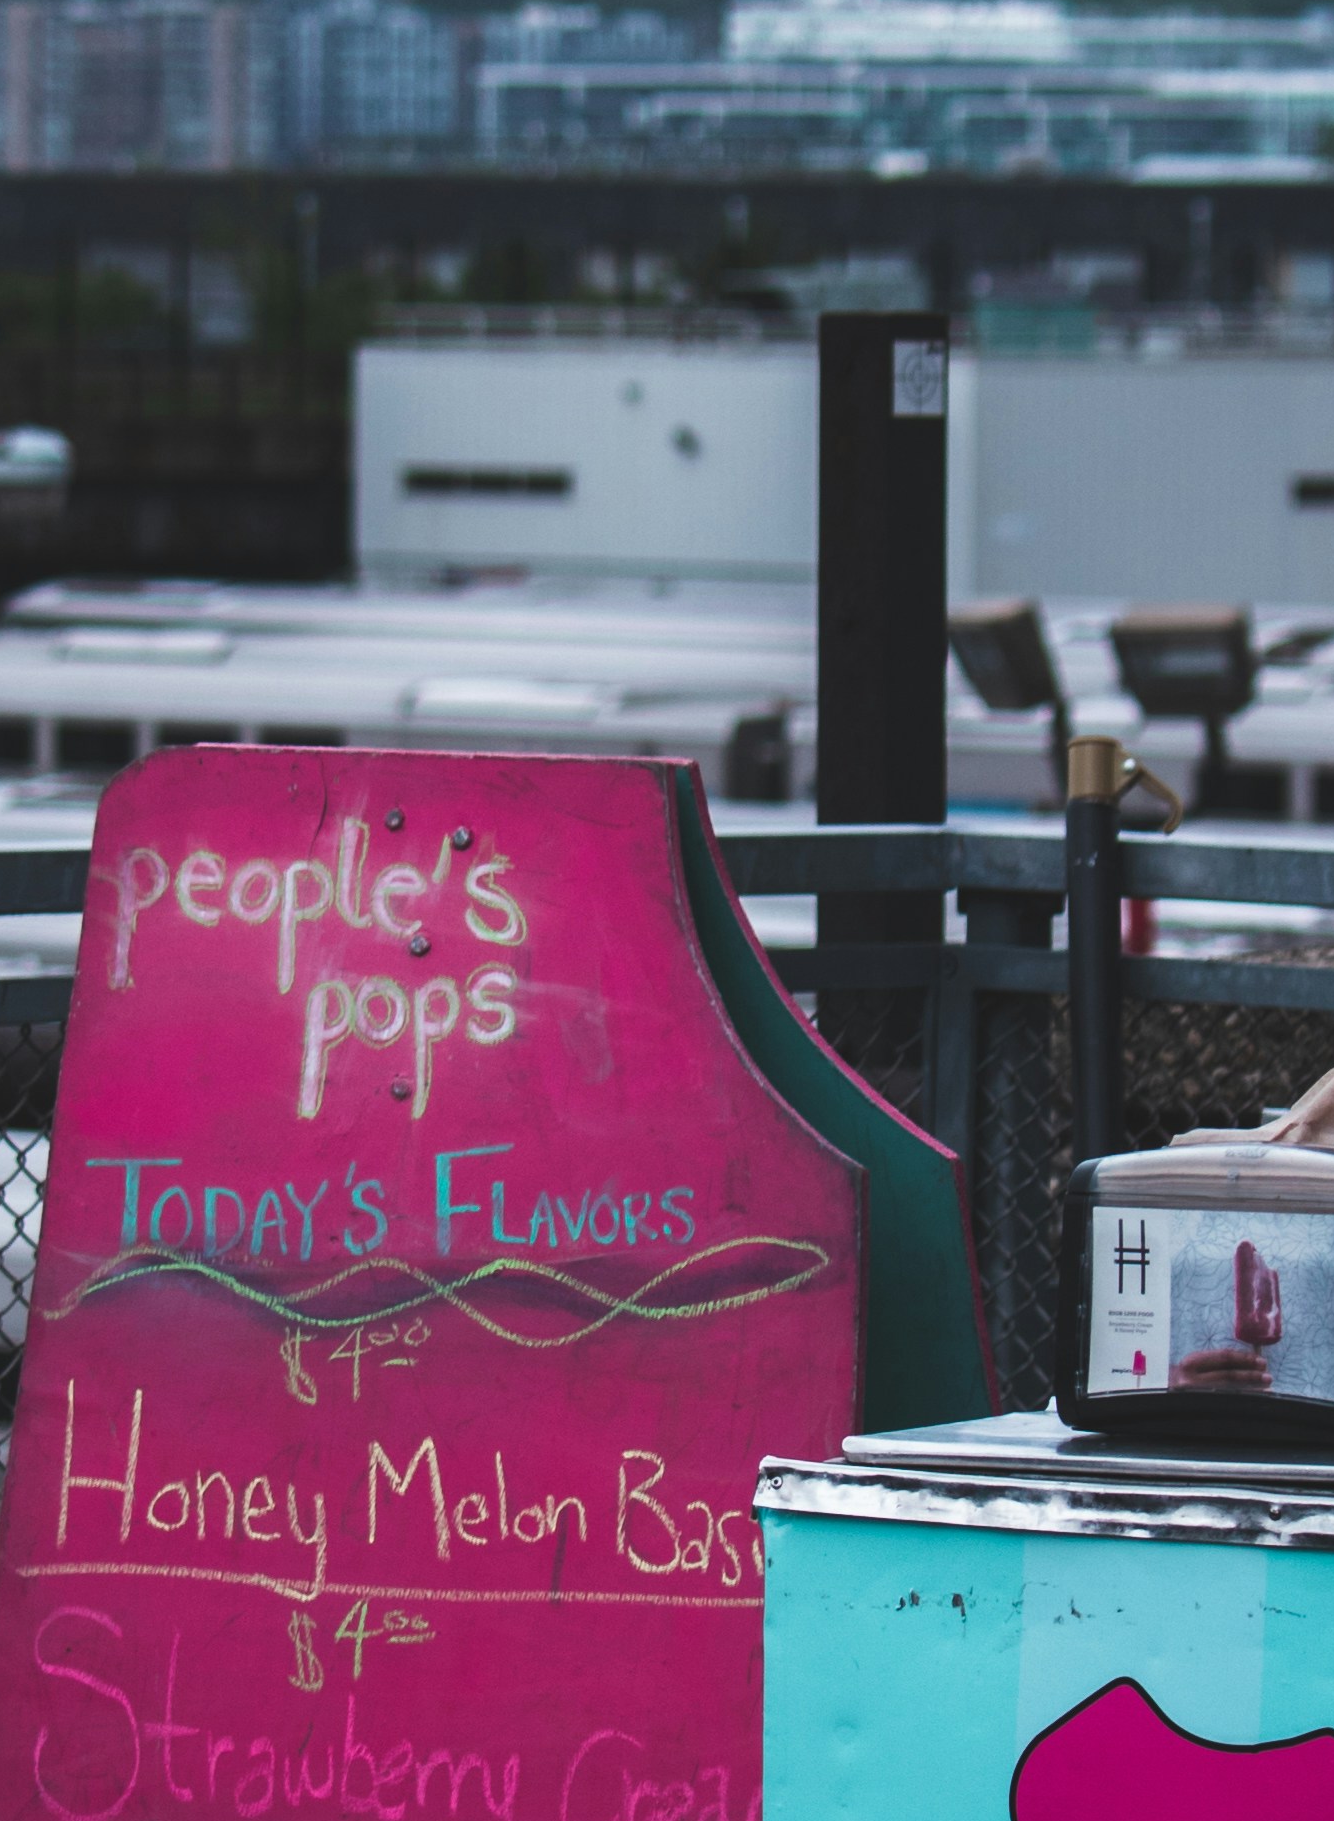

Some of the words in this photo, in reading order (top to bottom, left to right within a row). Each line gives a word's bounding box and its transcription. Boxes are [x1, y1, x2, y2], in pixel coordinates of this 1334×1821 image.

[107, 815, 529, 993] people's
[297, 961, 519, 1120] pops
[85, 1155, 388, 1261] TODAY'S
[433, 1143, 696, 1257] FLAVORS
[54, 1378, 328, 1602] Honey
[368, 1435, 588, 1561] Melon
